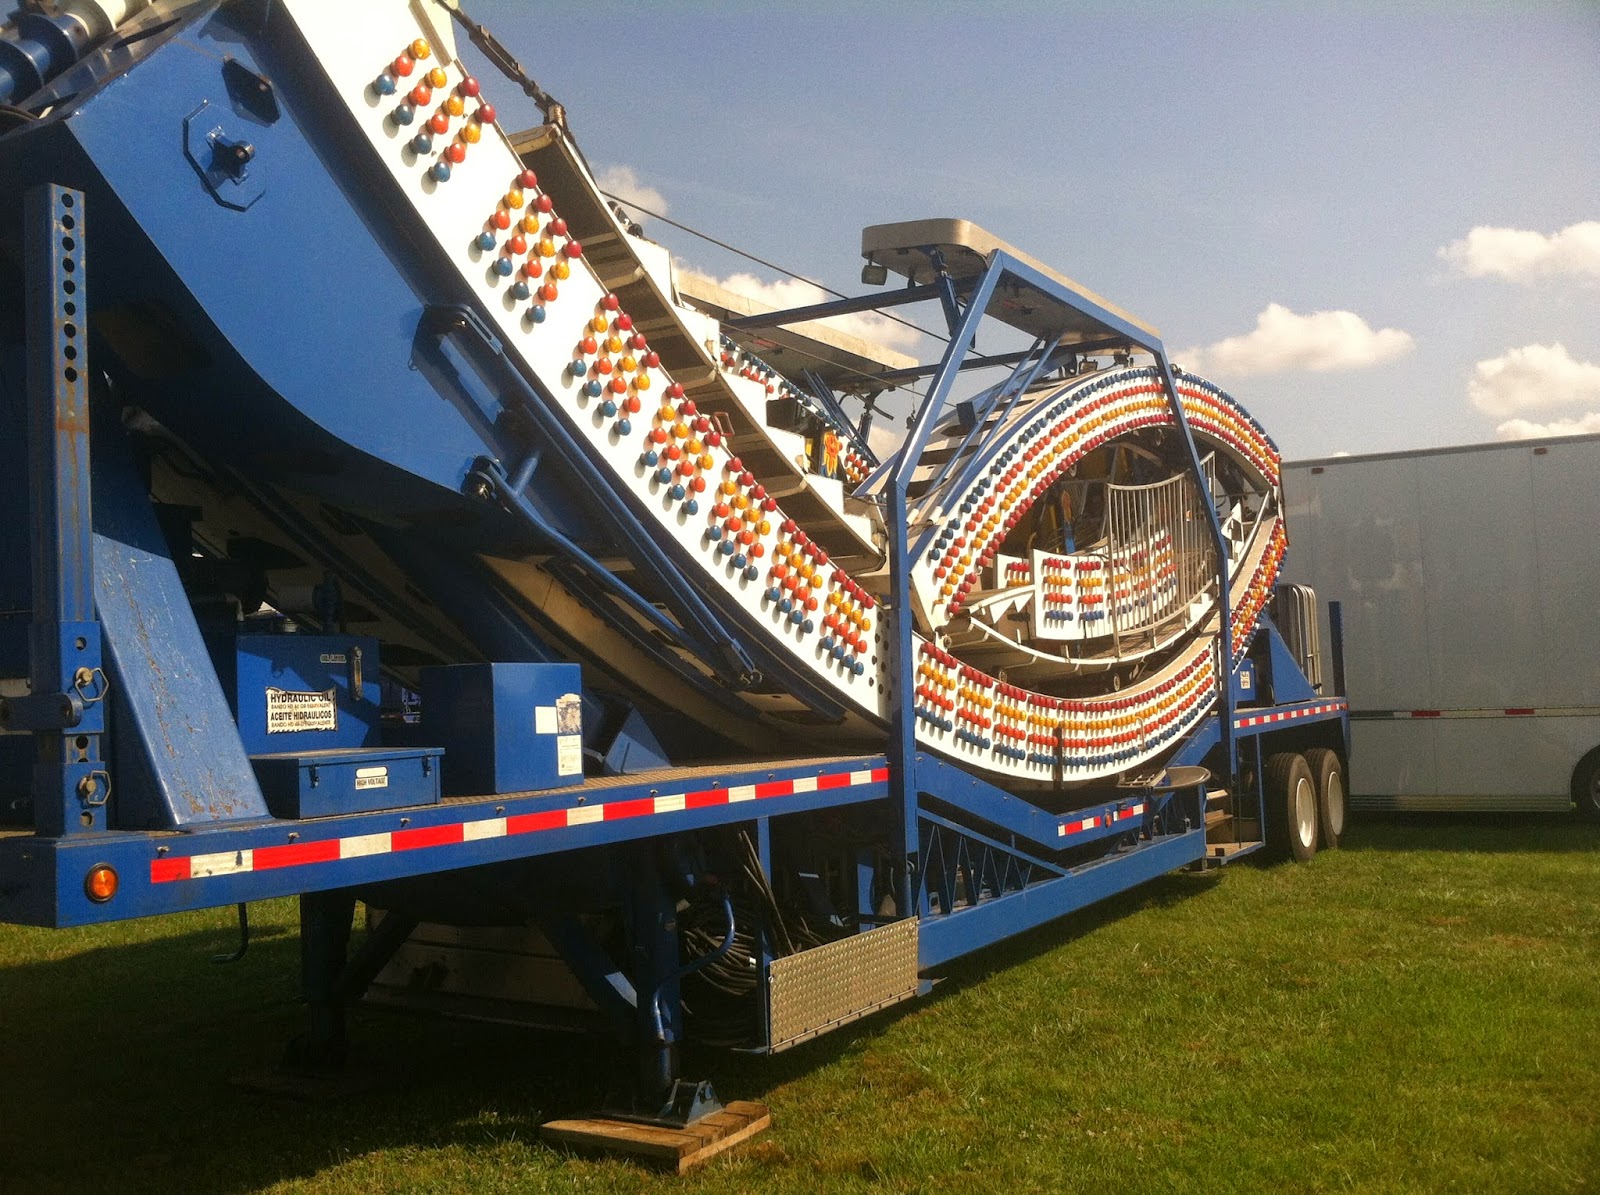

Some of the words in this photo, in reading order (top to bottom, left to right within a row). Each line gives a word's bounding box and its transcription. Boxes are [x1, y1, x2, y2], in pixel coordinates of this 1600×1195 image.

[270, 693, 317, 703] HYDRAULIC
[319, 692, 331, 702] OIL
[270, 711, 292, 721] ACEITE
[294, 711, 332, 720] HIDRAULICOS
[368, 777, 386, 785] VOLTAGE
